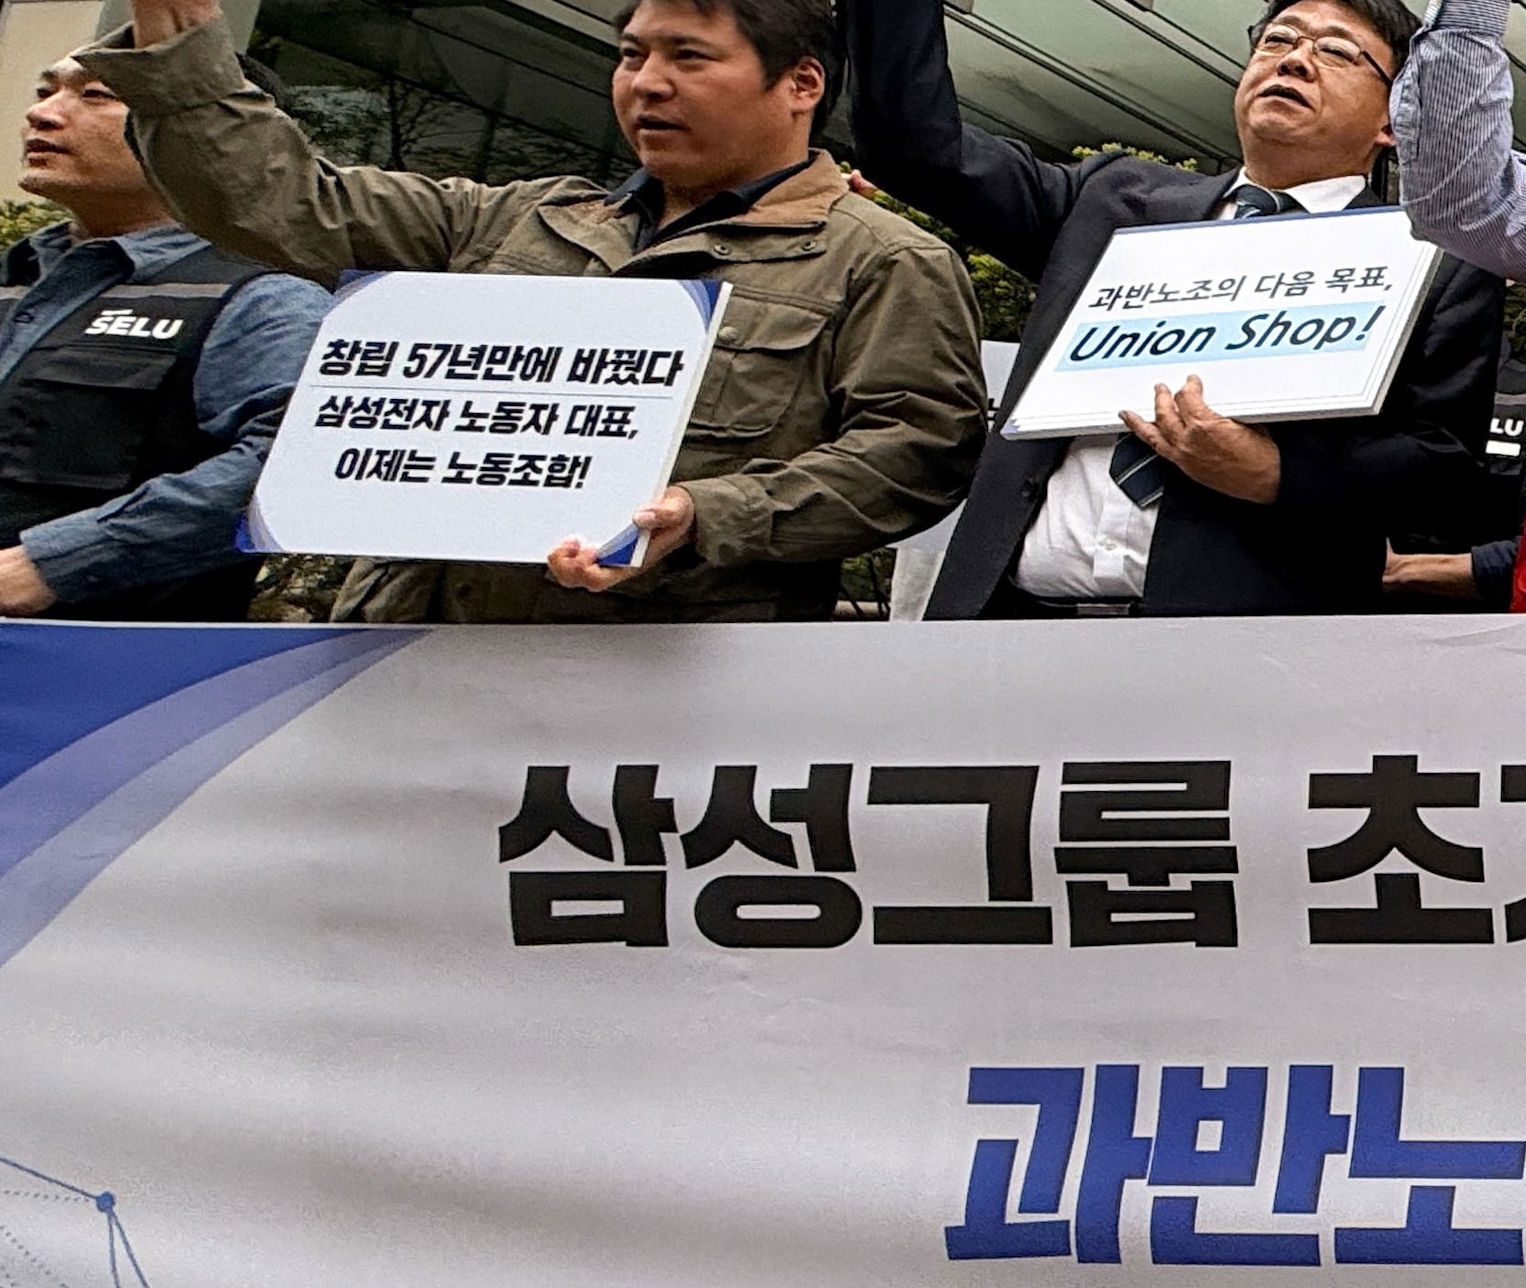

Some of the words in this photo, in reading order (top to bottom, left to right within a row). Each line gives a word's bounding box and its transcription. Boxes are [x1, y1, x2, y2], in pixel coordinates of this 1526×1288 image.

[1089, 277, 1245, 310] 과반노조의
[1255, 272, 1313, 297] 다음
[1325, 266, 1392, 293] 목표,
[85, 310, 183, 338] SELU
[1071, 321, 1215, 361] Union
[1227, 306, 1385, 349] Shop!
[320, 339, 399, 376] 창립
[403, 343, 561, 382] 57년만에
[567, 349, 683, 386] 바꿨다
[315, 396, 450, 431] 삼성전자
[457, 401, 559, 435] 노동자
[564, 405, 637, 439] 대표,
[1491, 419, 1523, 436] LU
[335, 449, 435, 482] 이제는
[442, 452, 591, 488] 노동조합!
[499, 761, 1239, 948] 삼성그룹
